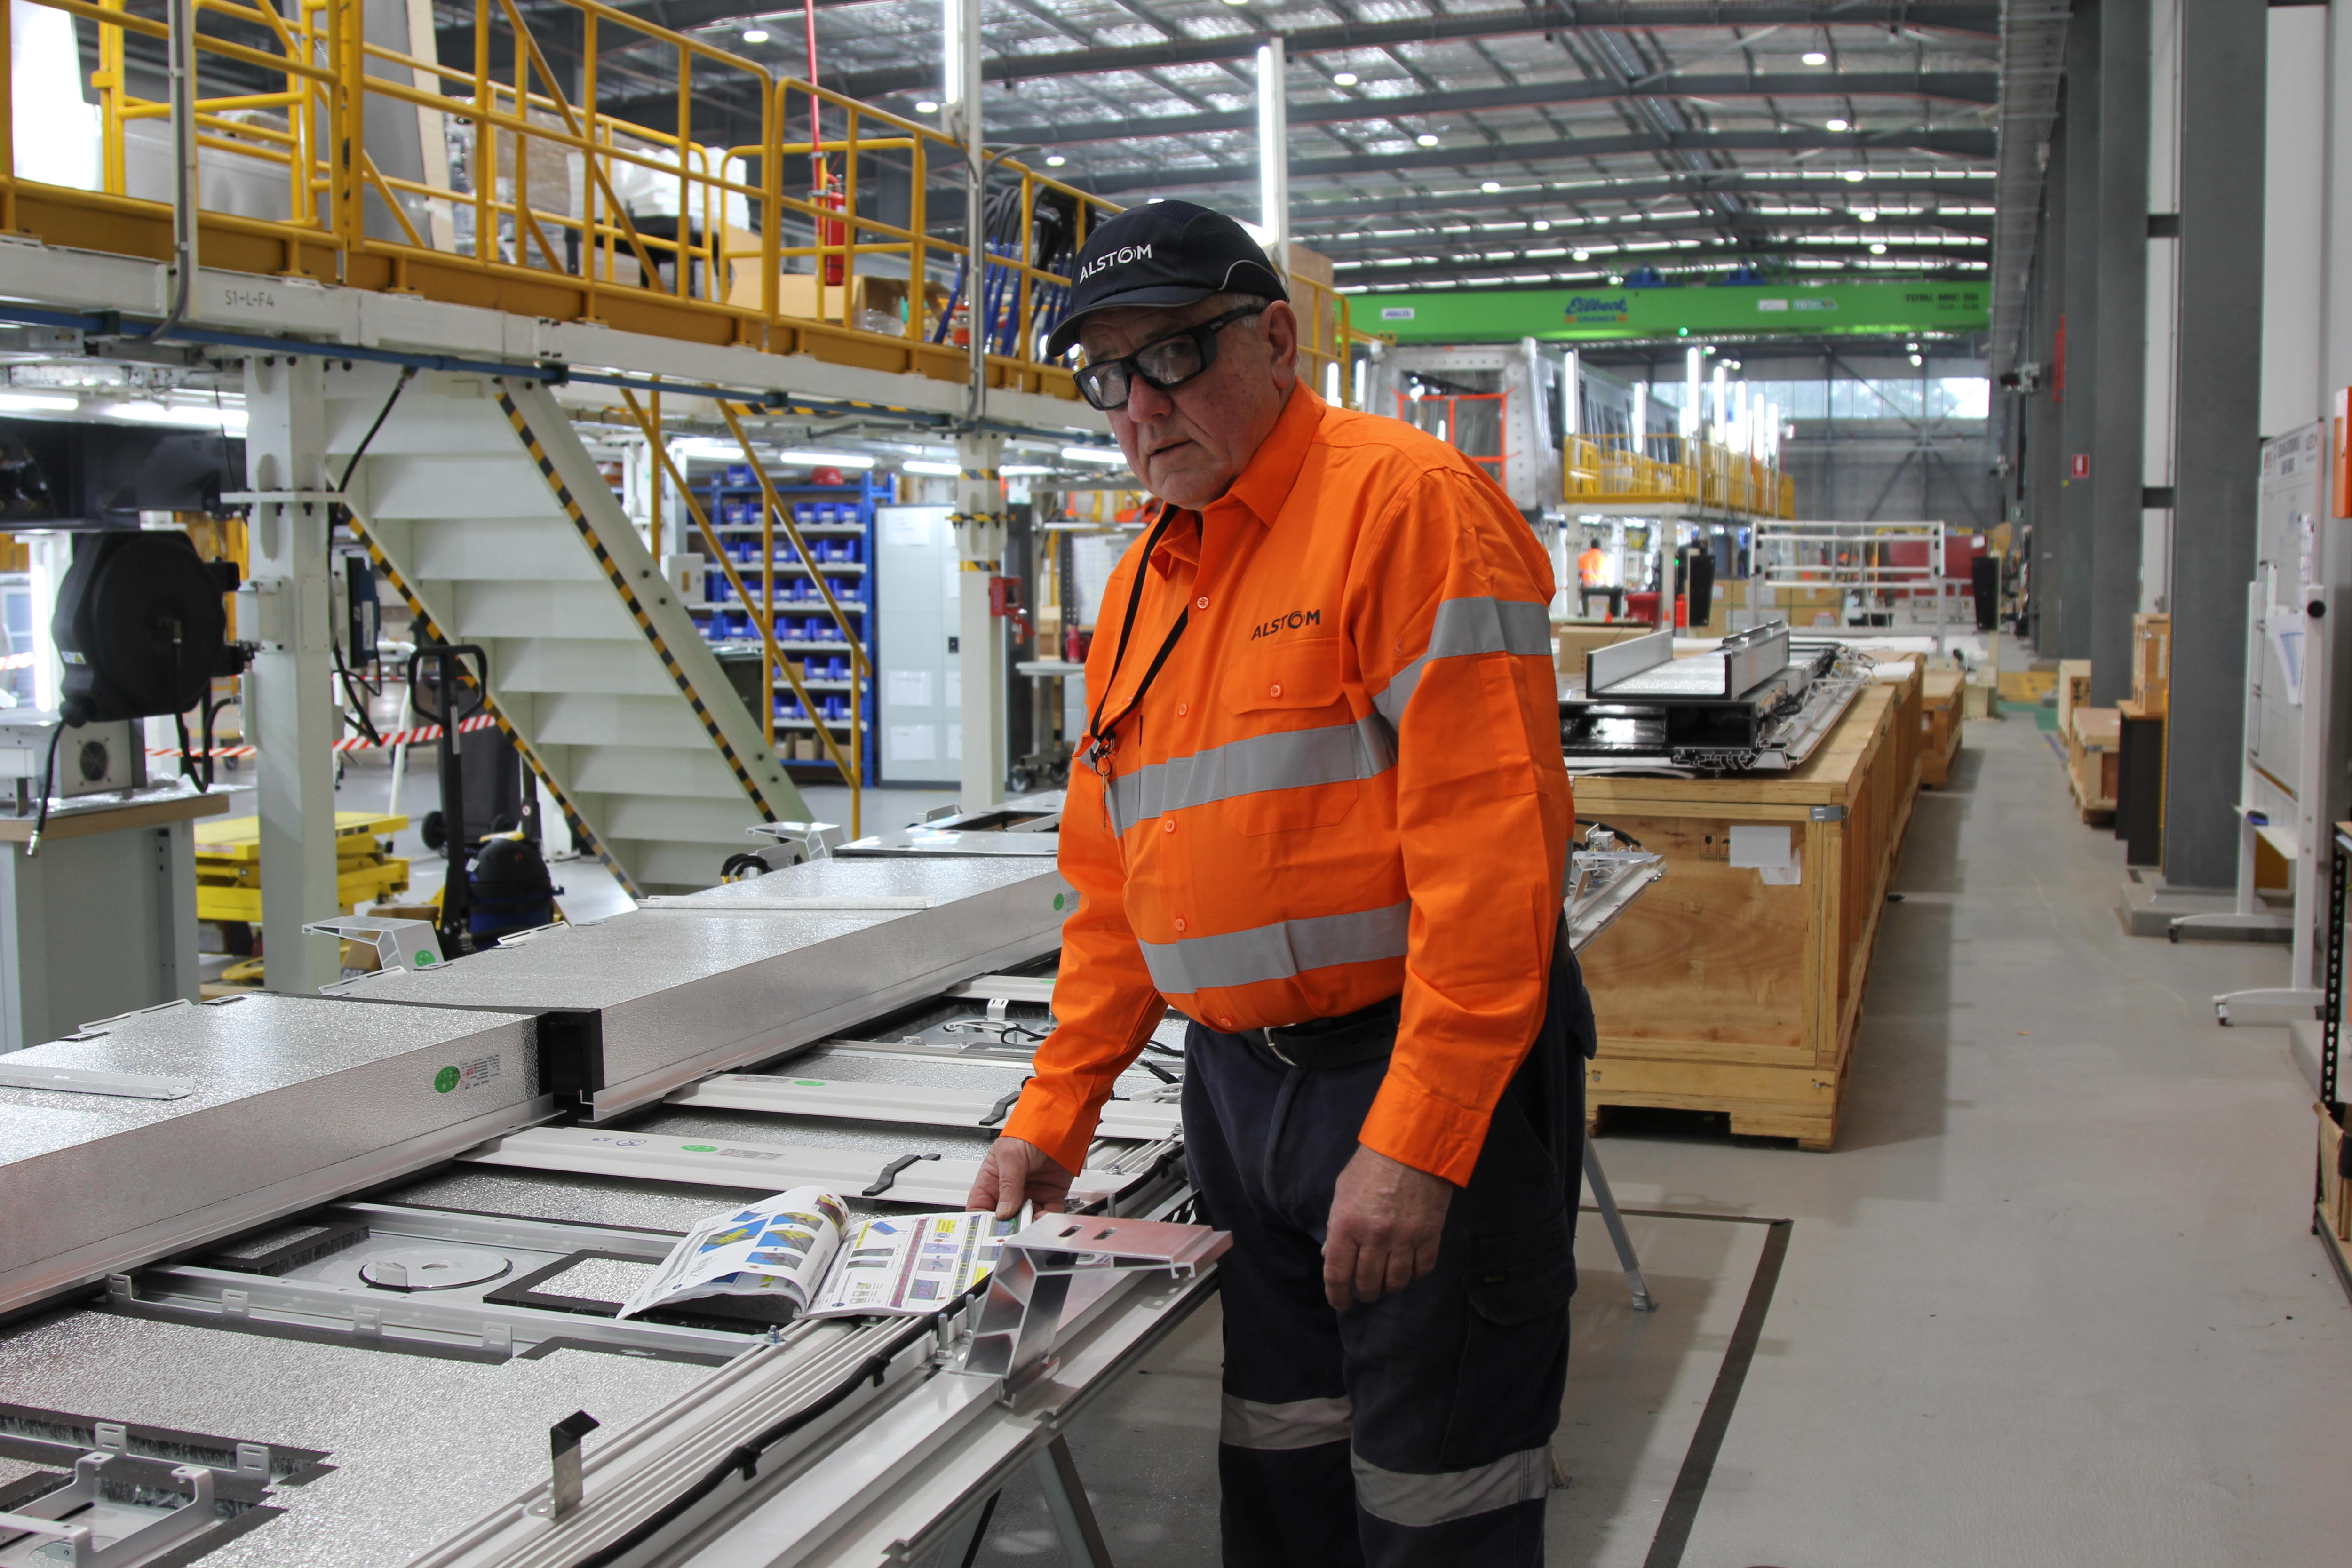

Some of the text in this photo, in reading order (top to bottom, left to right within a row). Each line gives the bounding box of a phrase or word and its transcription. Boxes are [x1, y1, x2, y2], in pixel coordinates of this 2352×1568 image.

[1079, 244, 1152, 284] ALSTOM
[225, 289, 274, 307] S1-L-F4
[1250, 609, 1320, 641] ALSTOM
